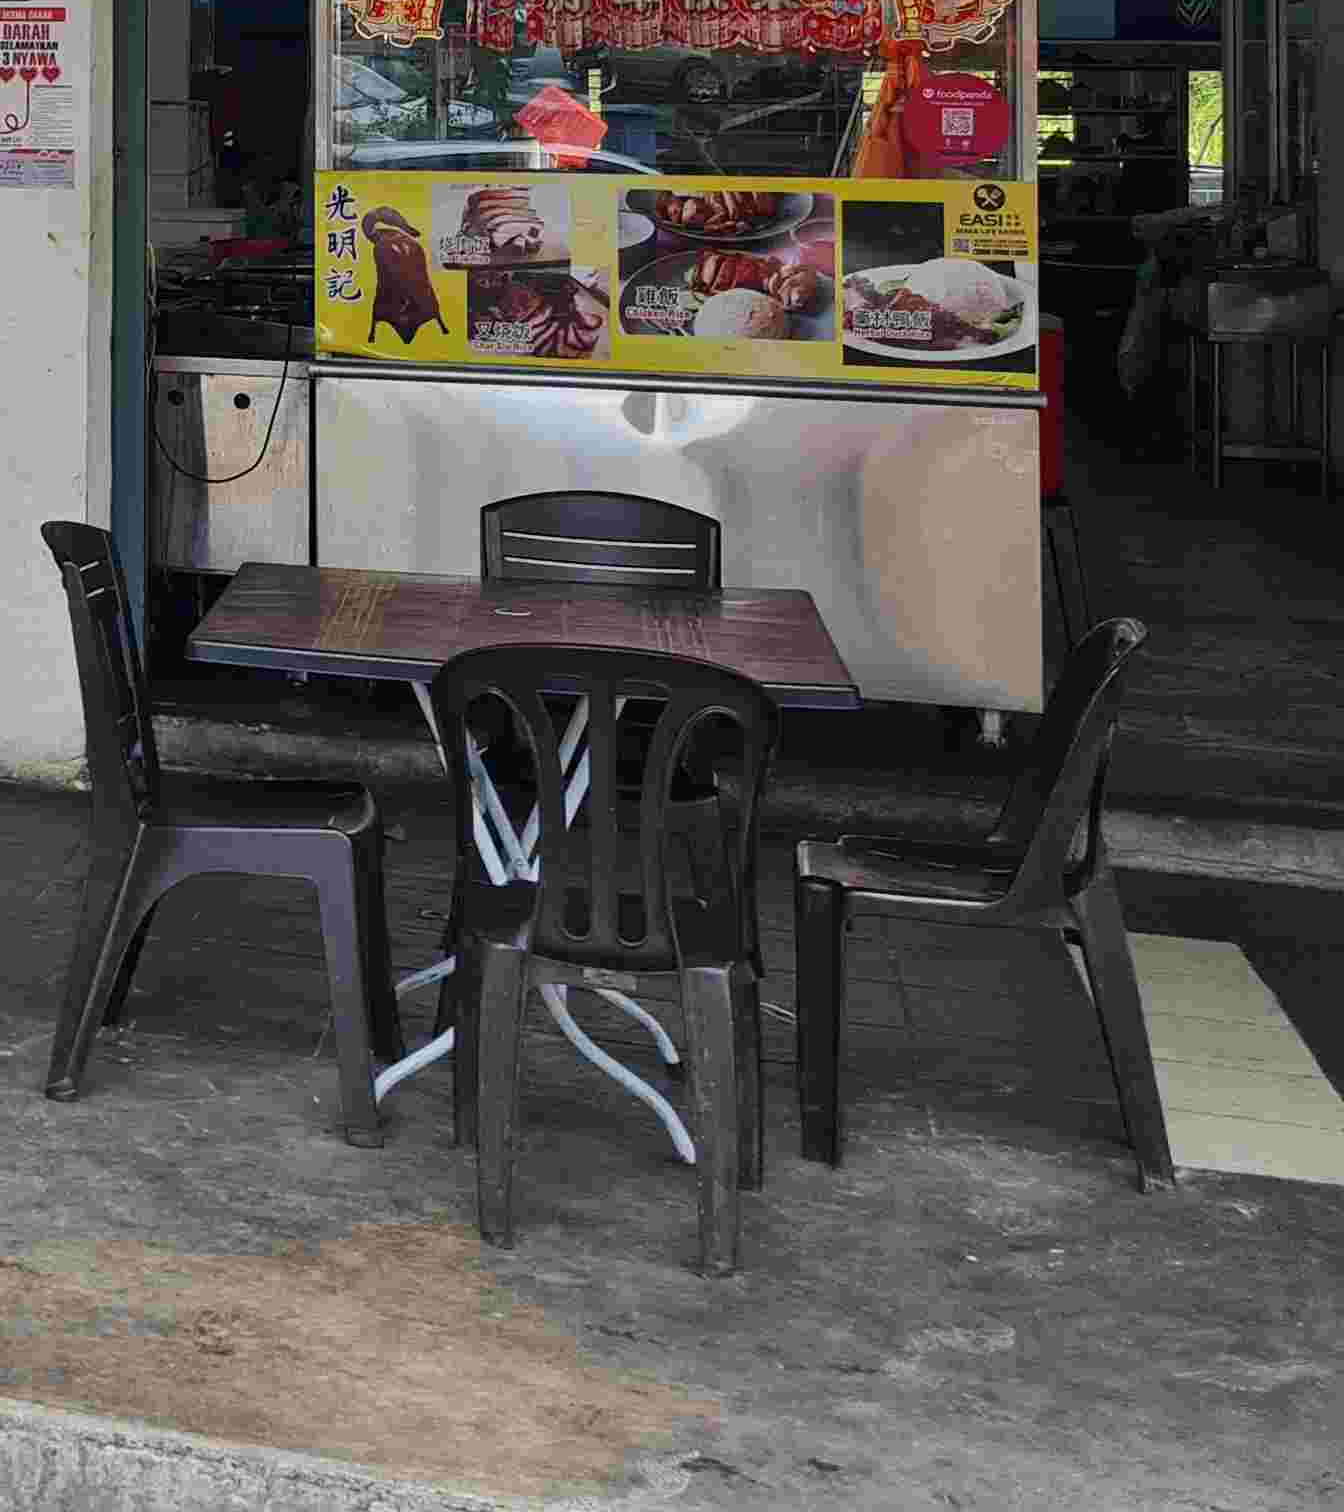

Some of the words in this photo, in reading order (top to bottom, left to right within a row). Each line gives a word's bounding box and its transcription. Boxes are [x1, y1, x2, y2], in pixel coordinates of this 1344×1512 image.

[3, 24, 50, 40] DARAH
[0, 41, 58, 50] SELAMATKAN
[2, 52, 10, 66] 3
[12, 52, 57, 66] NYAWA
[936, 88, 992, 101] foodpanda
[960, 214, 1002, 227] EASI
[325, 184, 361, 302] 光明記
